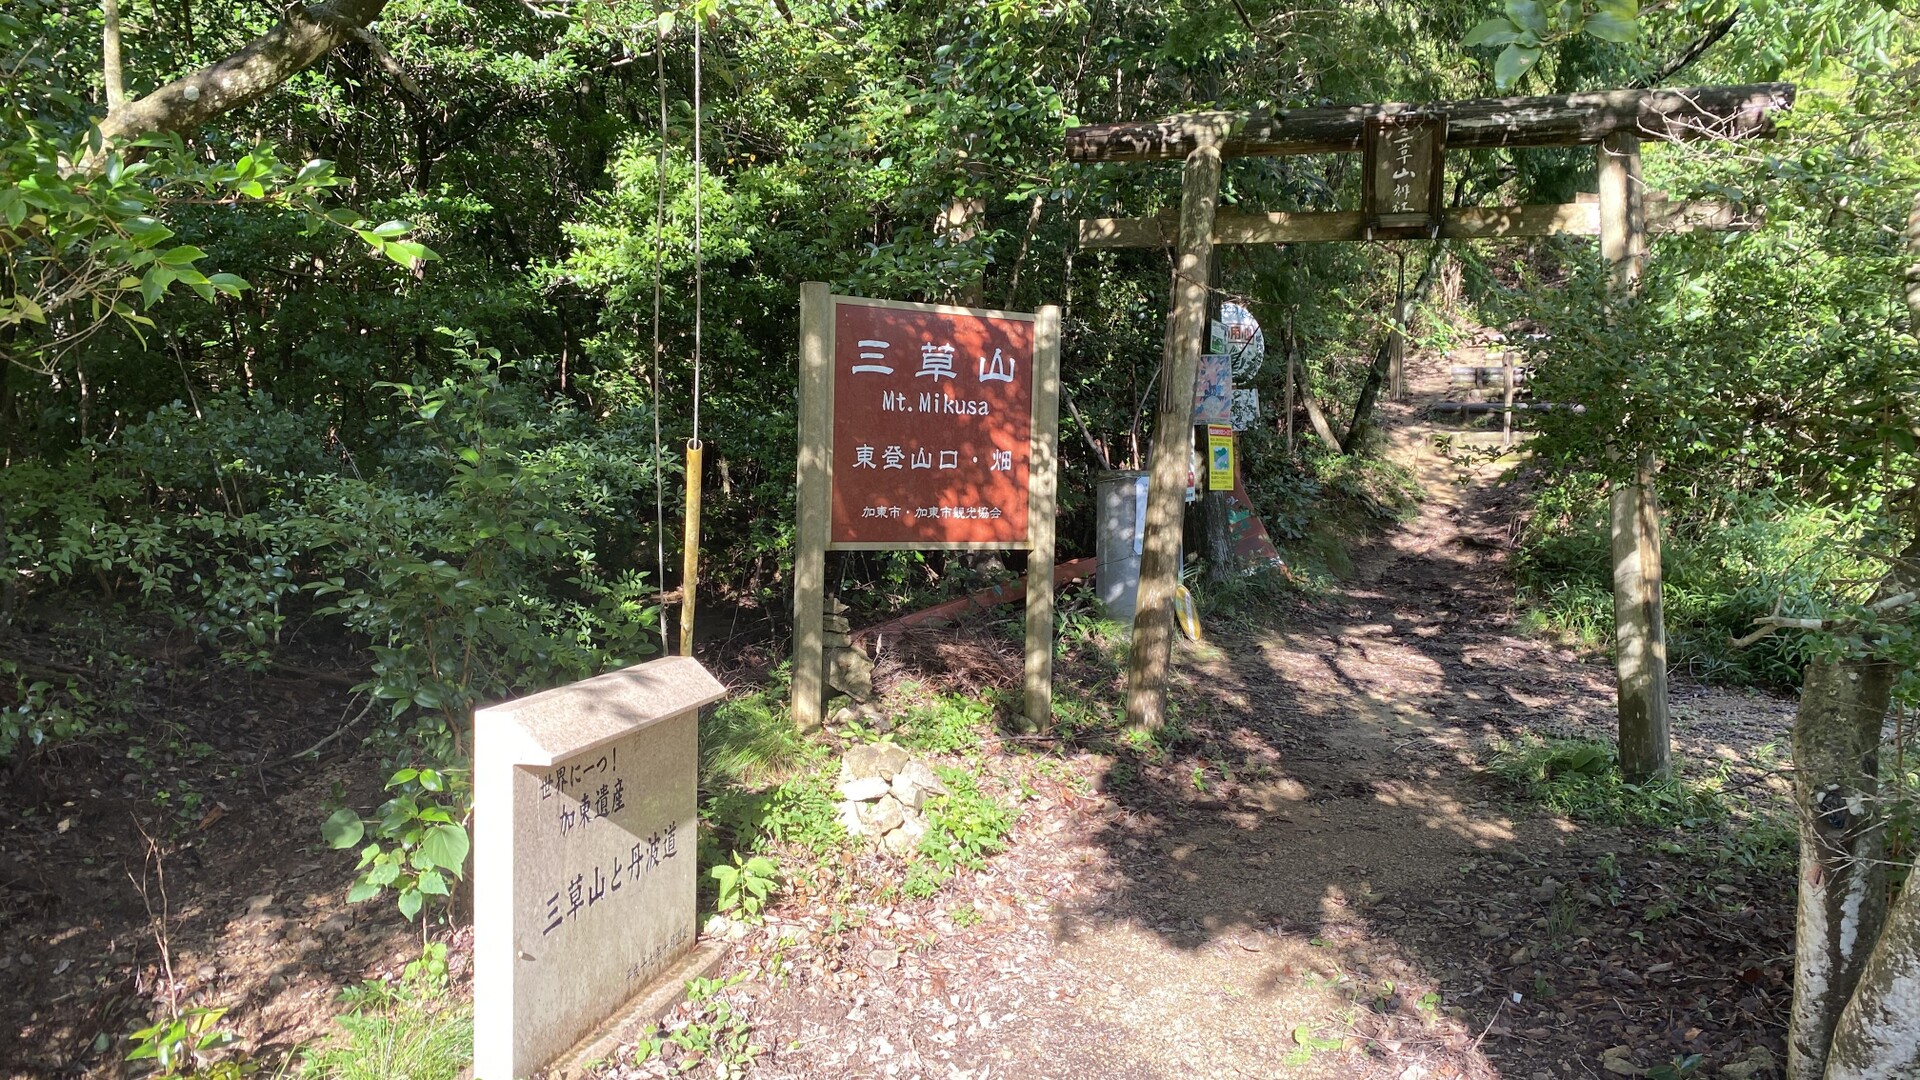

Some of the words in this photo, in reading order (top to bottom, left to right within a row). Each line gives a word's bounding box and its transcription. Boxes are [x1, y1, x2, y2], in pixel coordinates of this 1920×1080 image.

[1392, 126, 1416, 213] 三草山神社
[851, 339, 1016, 383] 三草山
[852, 443, 1012, 471] 東登山口・畑
[560, 778, 625, 837] 加東遺産
[543, 821, 677, 936] 三草山と丹波道
